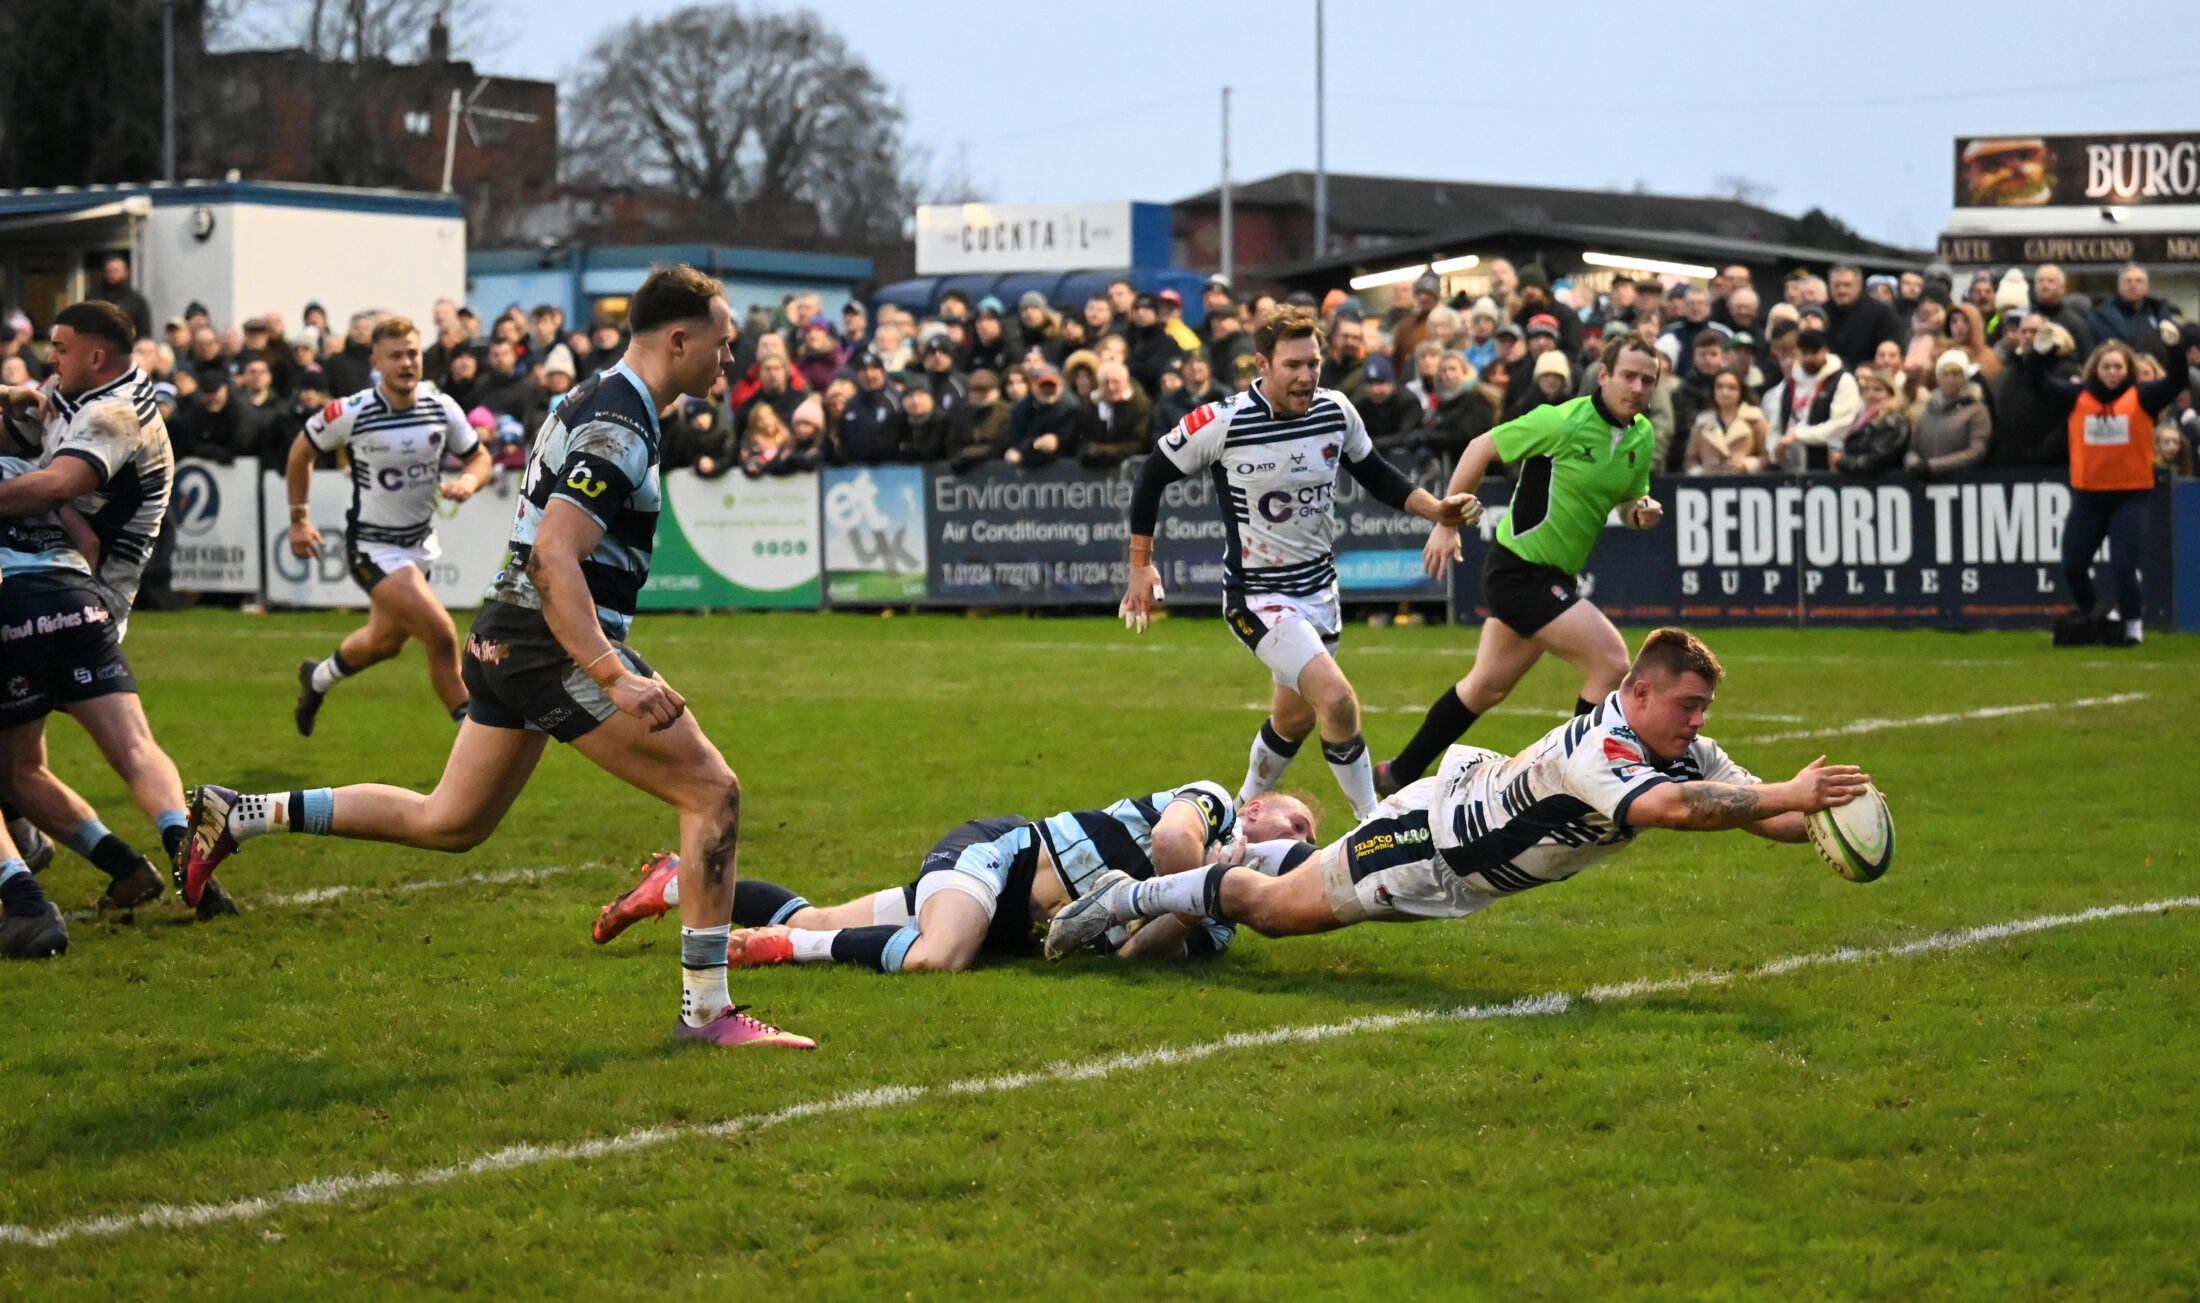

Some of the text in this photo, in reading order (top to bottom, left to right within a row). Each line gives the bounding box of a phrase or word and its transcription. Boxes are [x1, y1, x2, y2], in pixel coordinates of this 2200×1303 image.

[2085, 142, 2200, 198] BURG
[2024, 237, 2134, 261] CAPPUCCINO
[1256, 462, 1276, 471] ATD
[935, 476, 1133, 512] Environmenta
[942, 522, 968, 542] Air
[971, 519, 1089, 545] Conditioning
[1093, 519, 1131, 541] and
[1165, 516, 1227, 540] Sourc
[1676, 483, 2110, 566] BEDFORD TIMB
[1682, 569, 1980, 595] SUPPLIES
[1, 619, 34, 643] Paul
[37, 612, 83, 635] Riches
[1354, 834, 1393, 853] marco
